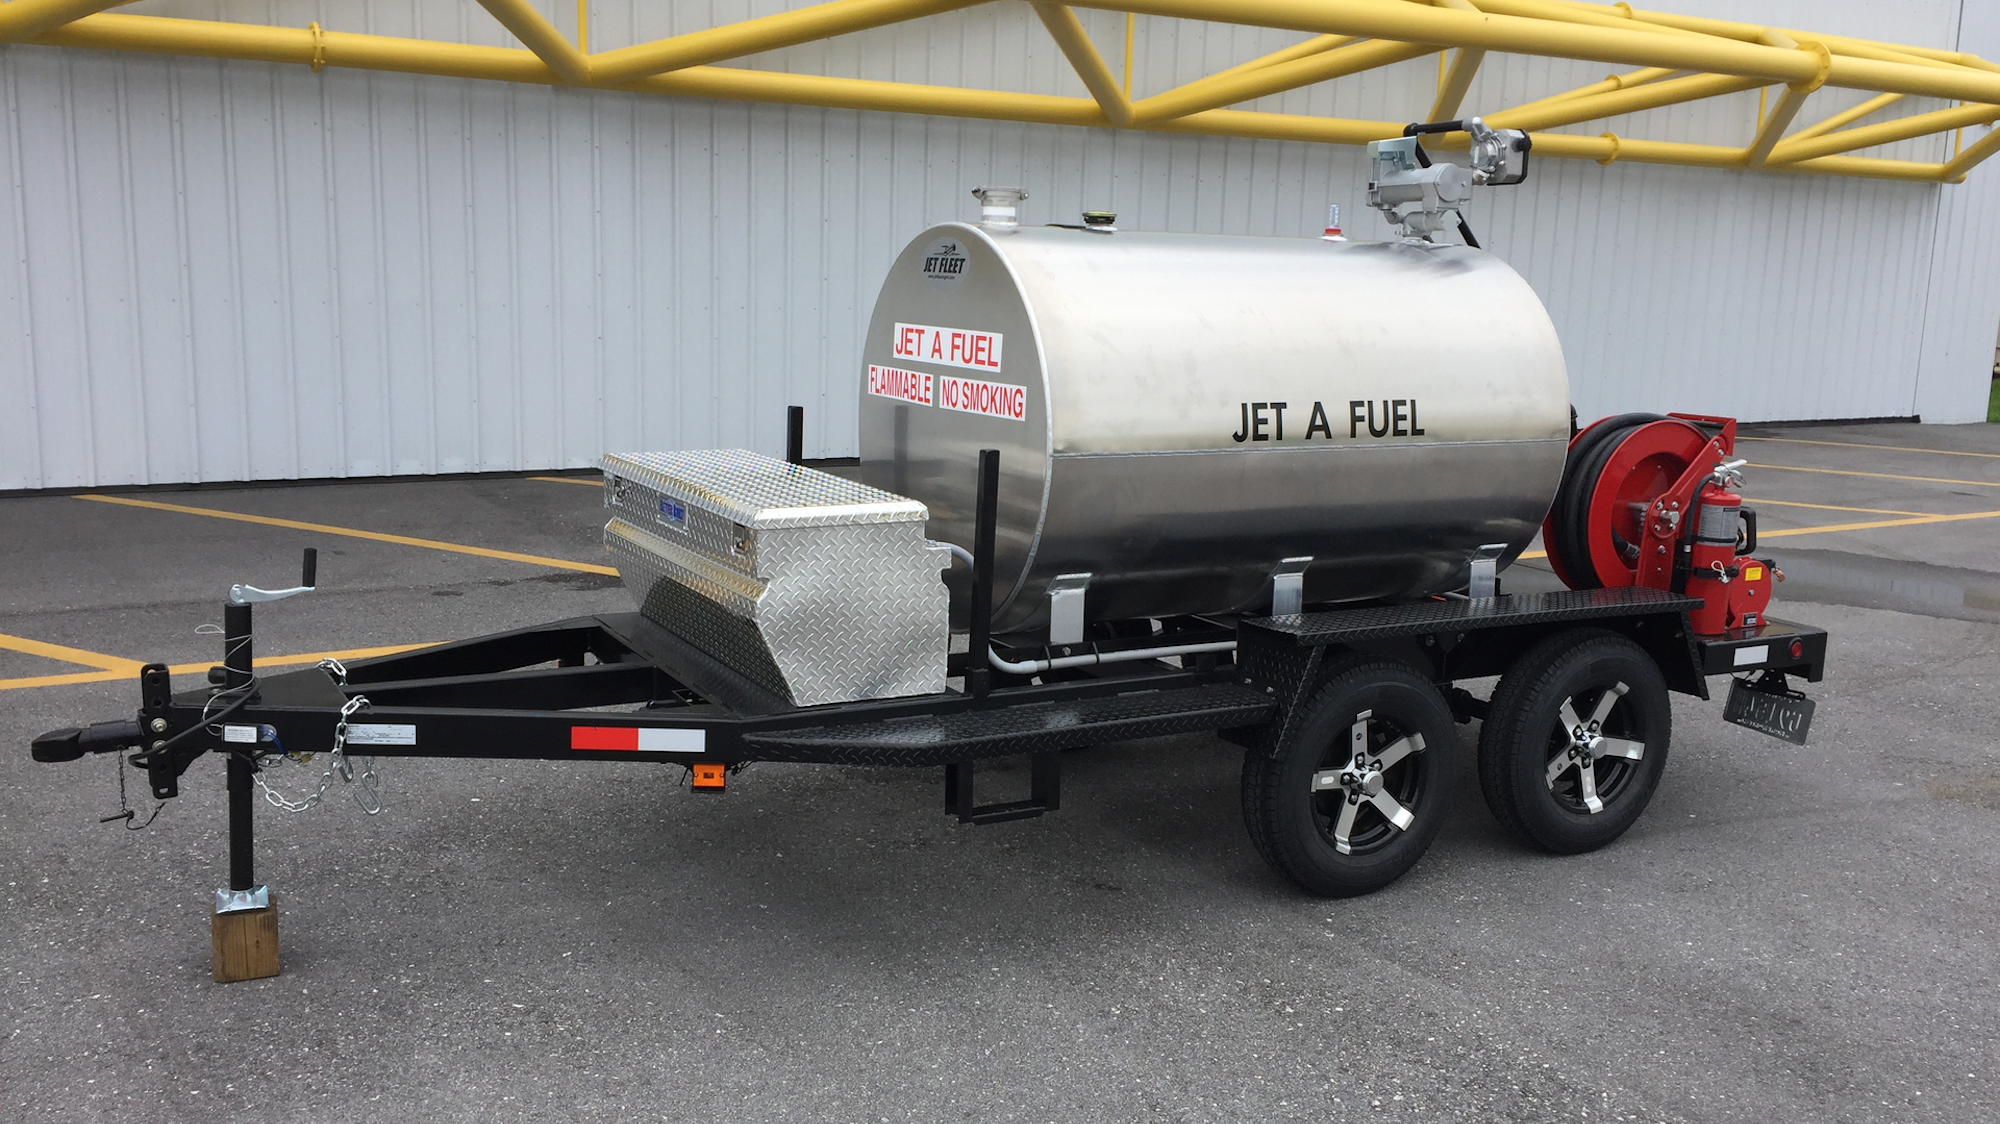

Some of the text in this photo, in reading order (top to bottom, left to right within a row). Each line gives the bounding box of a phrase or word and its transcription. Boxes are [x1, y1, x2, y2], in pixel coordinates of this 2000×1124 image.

[923, 257, 966, 274] JET FLEET
[895, 327, 999, 368] JET A FUEL
[870, 366, 932, 404] FLAMMABLE
[942, 379, 1024, 418] NO SMOKING
[1232, 399, 1426, 443] JET A FUEL
